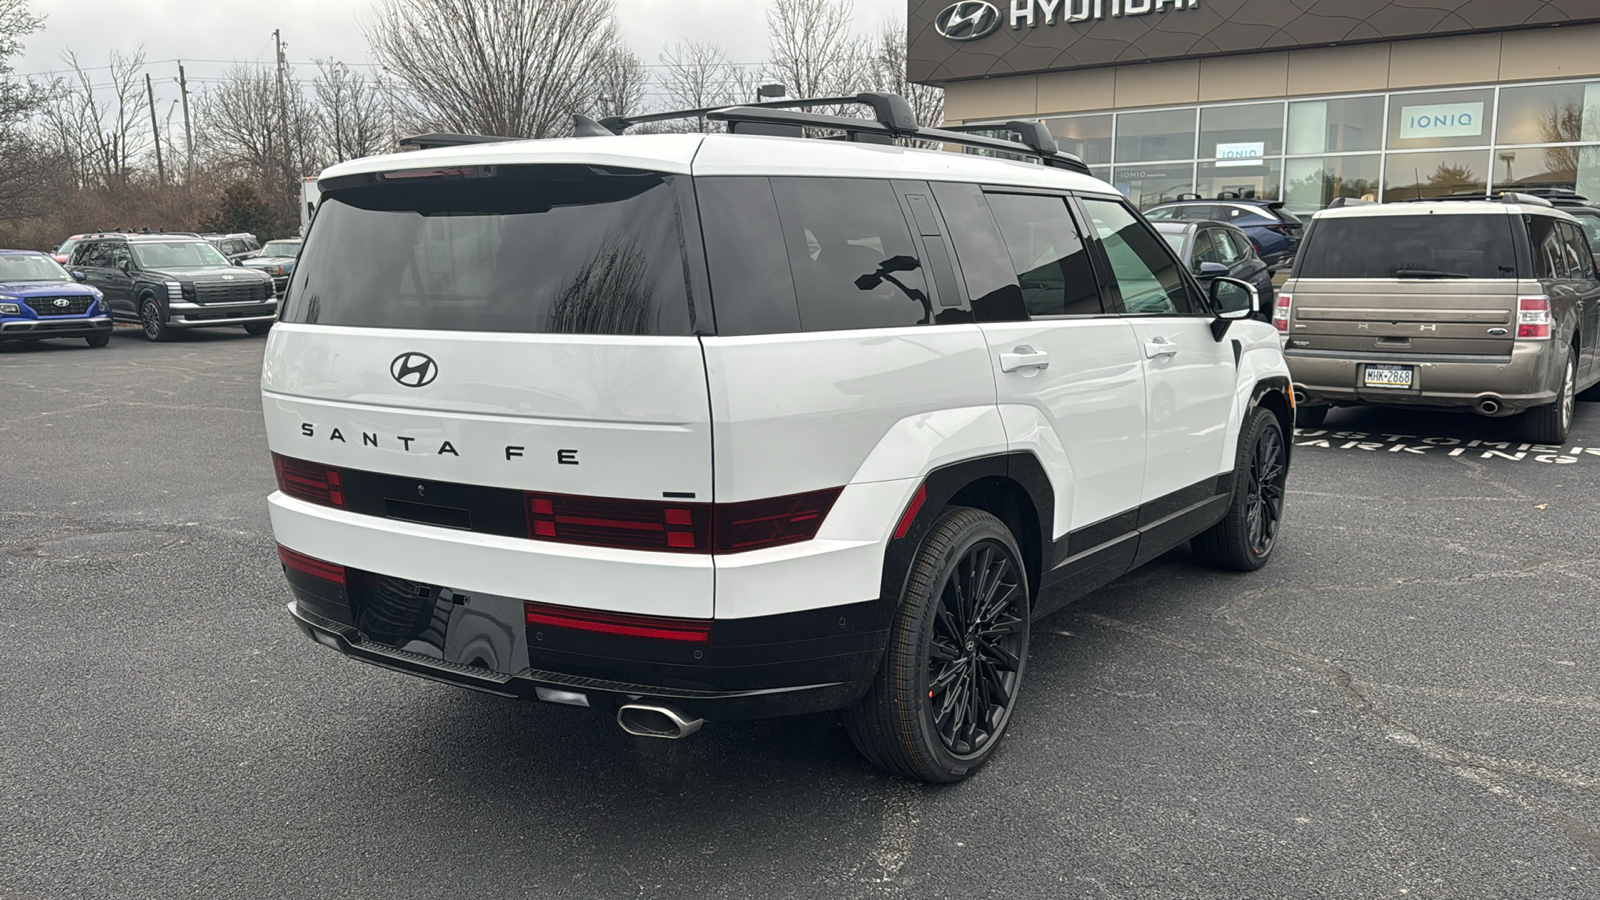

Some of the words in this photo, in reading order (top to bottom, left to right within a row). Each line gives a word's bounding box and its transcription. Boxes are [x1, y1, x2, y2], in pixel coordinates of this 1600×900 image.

[1410, 113, 1472, 129] IONIQ
[301, 422, 460, 456] SANTA
[505, 445, 579, 465] FE
[1293, 428, 1600, 456] USTOMER
[1294, 439, 1579, 464] ARKING
